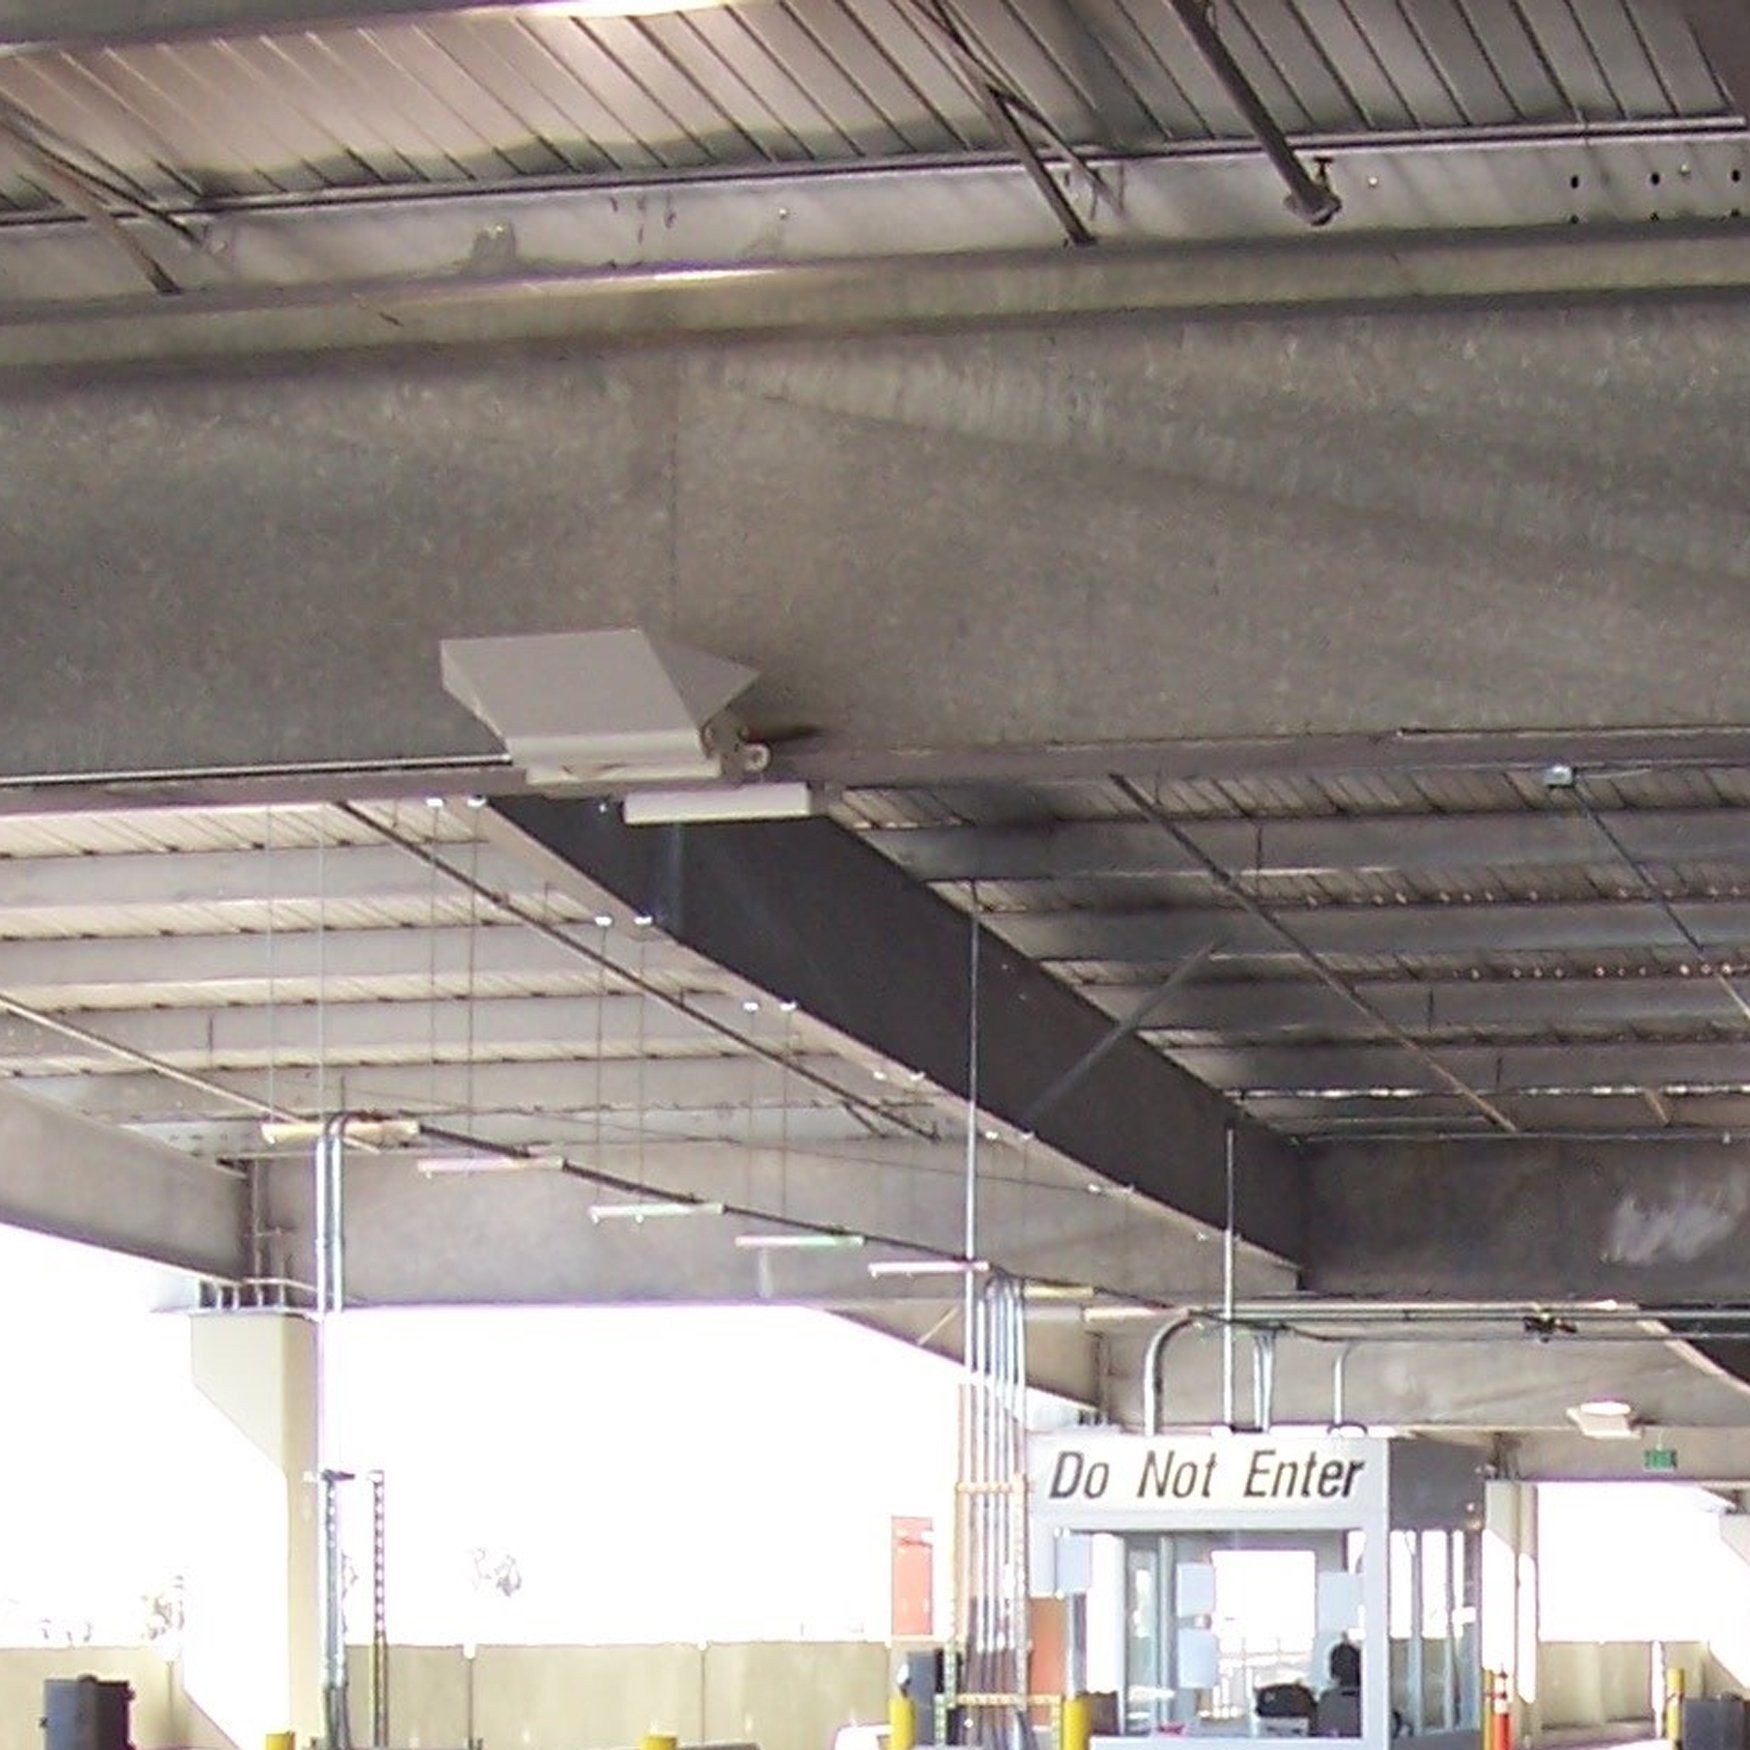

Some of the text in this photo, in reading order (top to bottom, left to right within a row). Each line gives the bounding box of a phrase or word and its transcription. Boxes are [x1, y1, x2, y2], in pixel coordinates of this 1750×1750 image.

[1049, 1449, 1365, 1499] Do Not Enter
